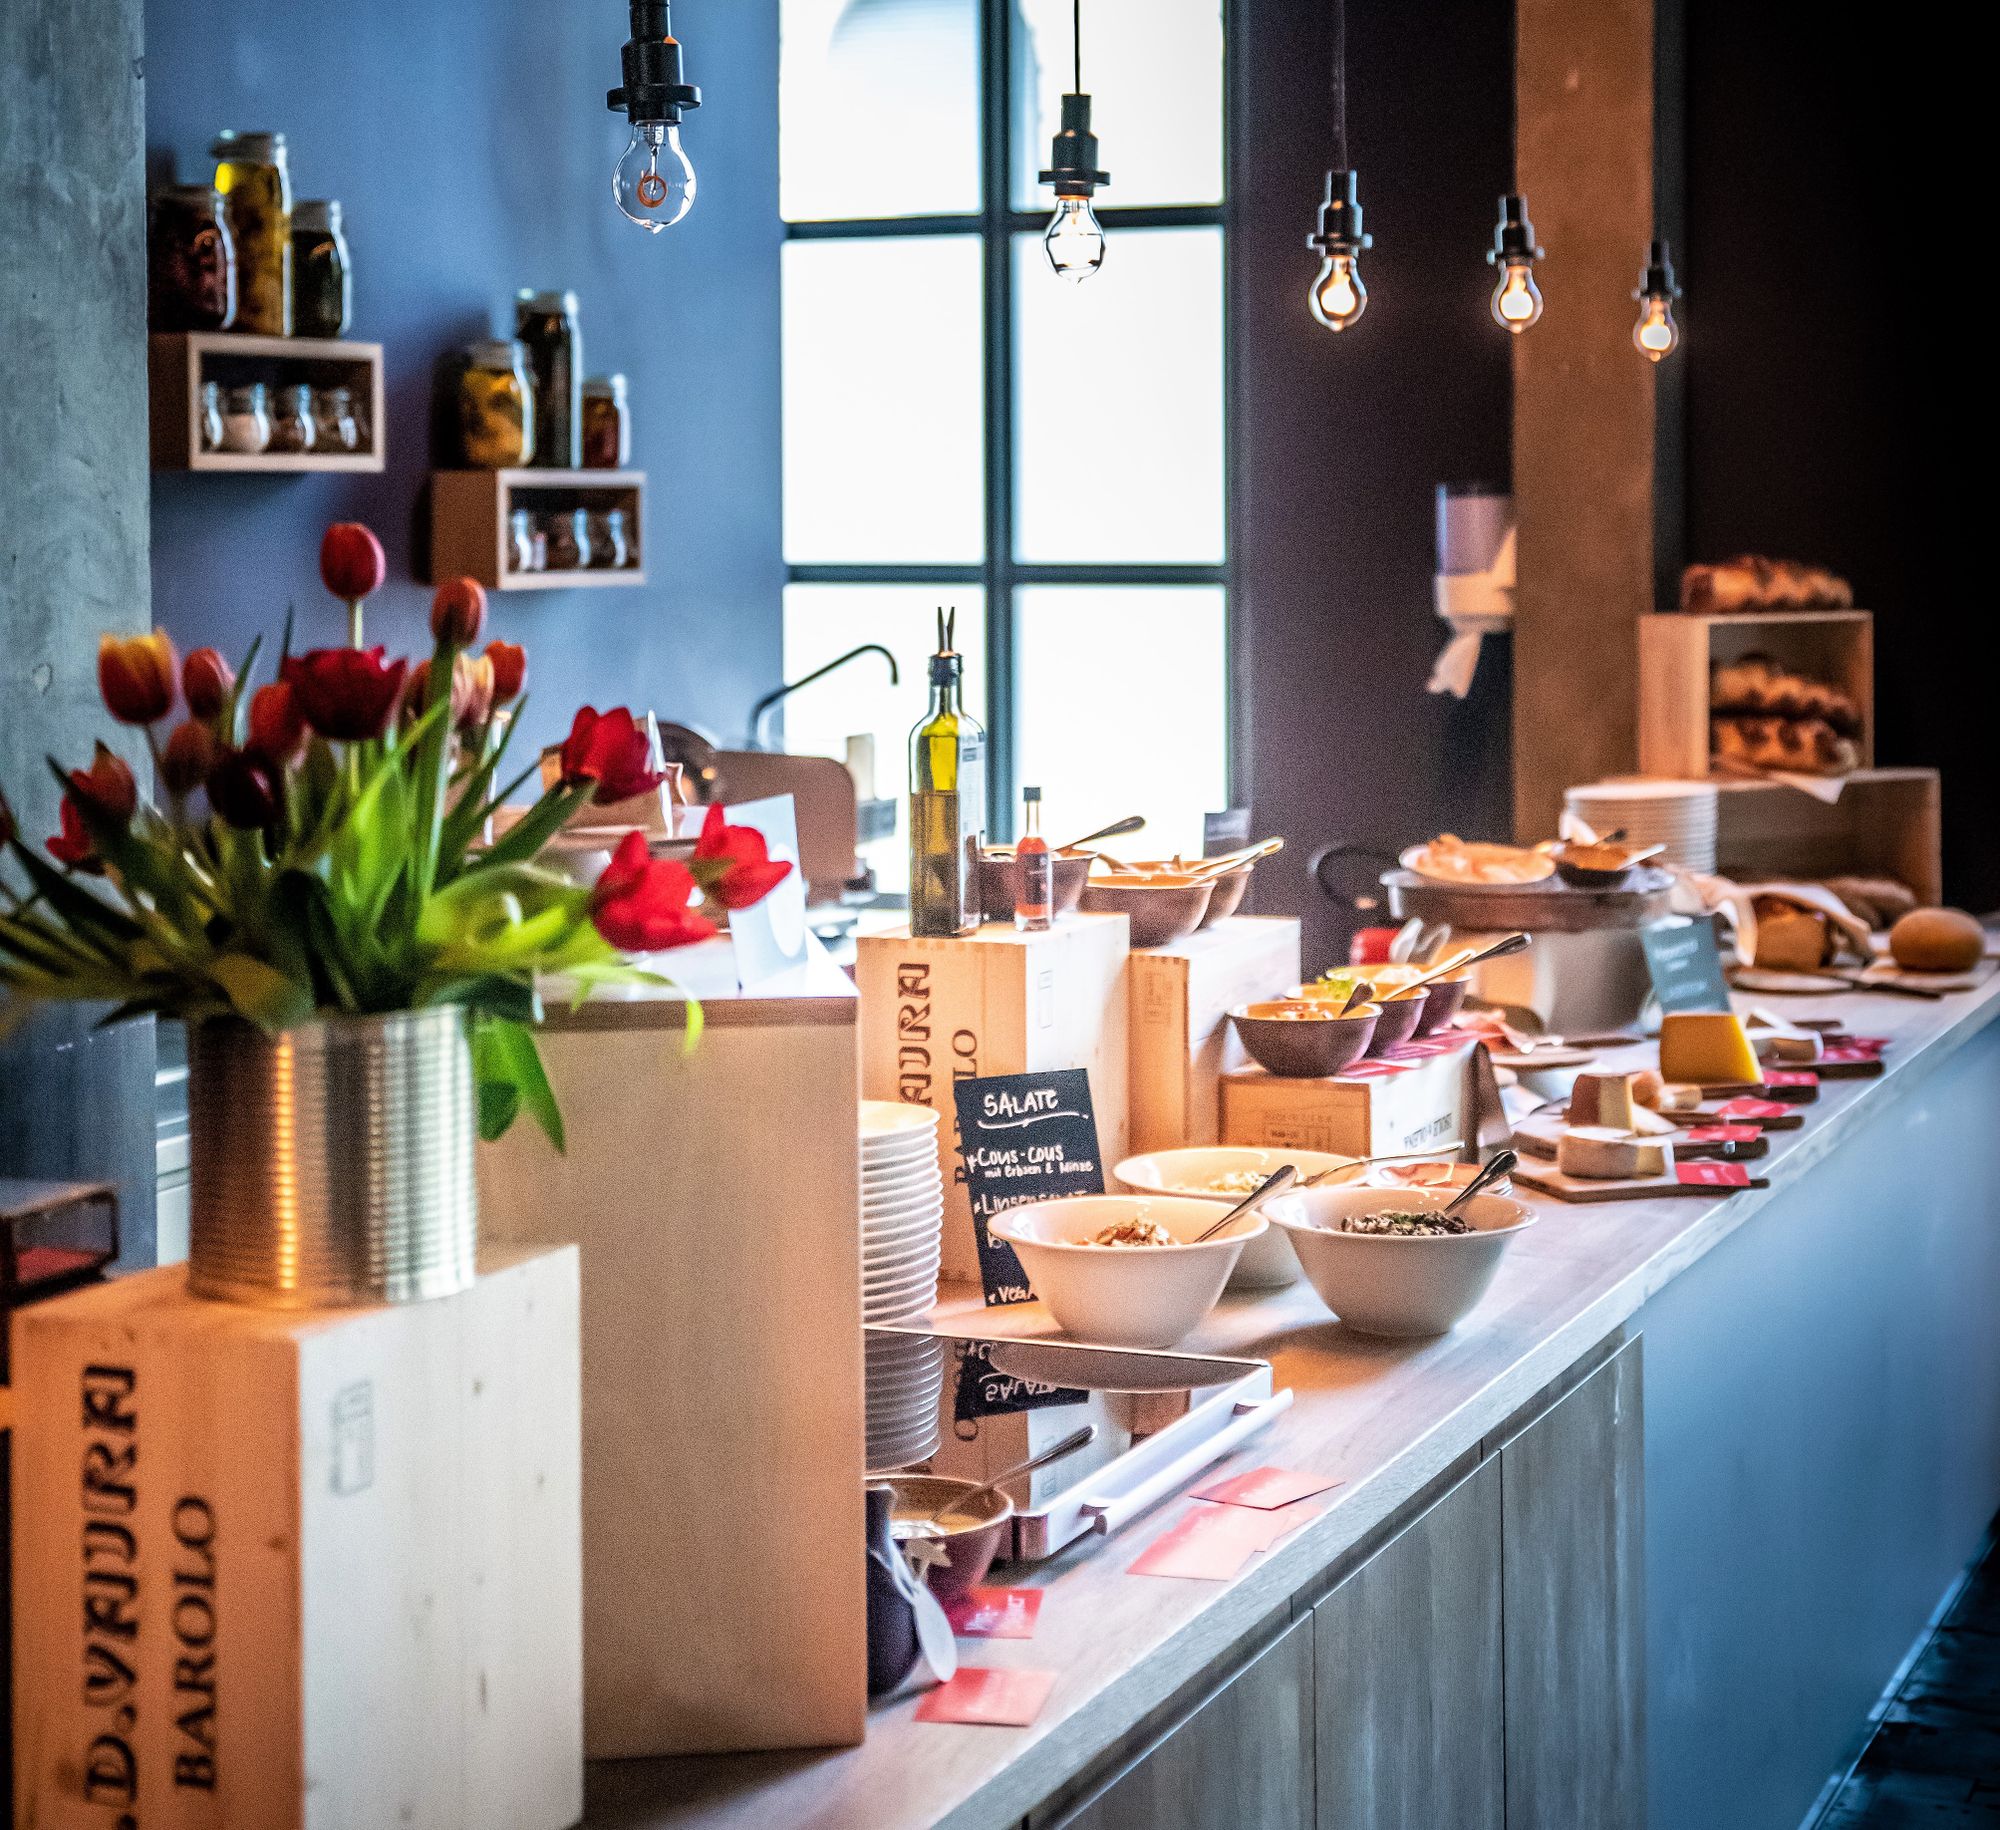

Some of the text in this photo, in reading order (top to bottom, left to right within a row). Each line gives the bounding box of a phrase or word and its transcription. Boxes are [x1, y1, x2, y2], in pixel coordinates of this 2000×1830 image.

[897, 962, 933, 1106] AJRA
[983, 1089, 1059, 1118] SALATE
[171, 1495, 218, 1791] BAROLO
